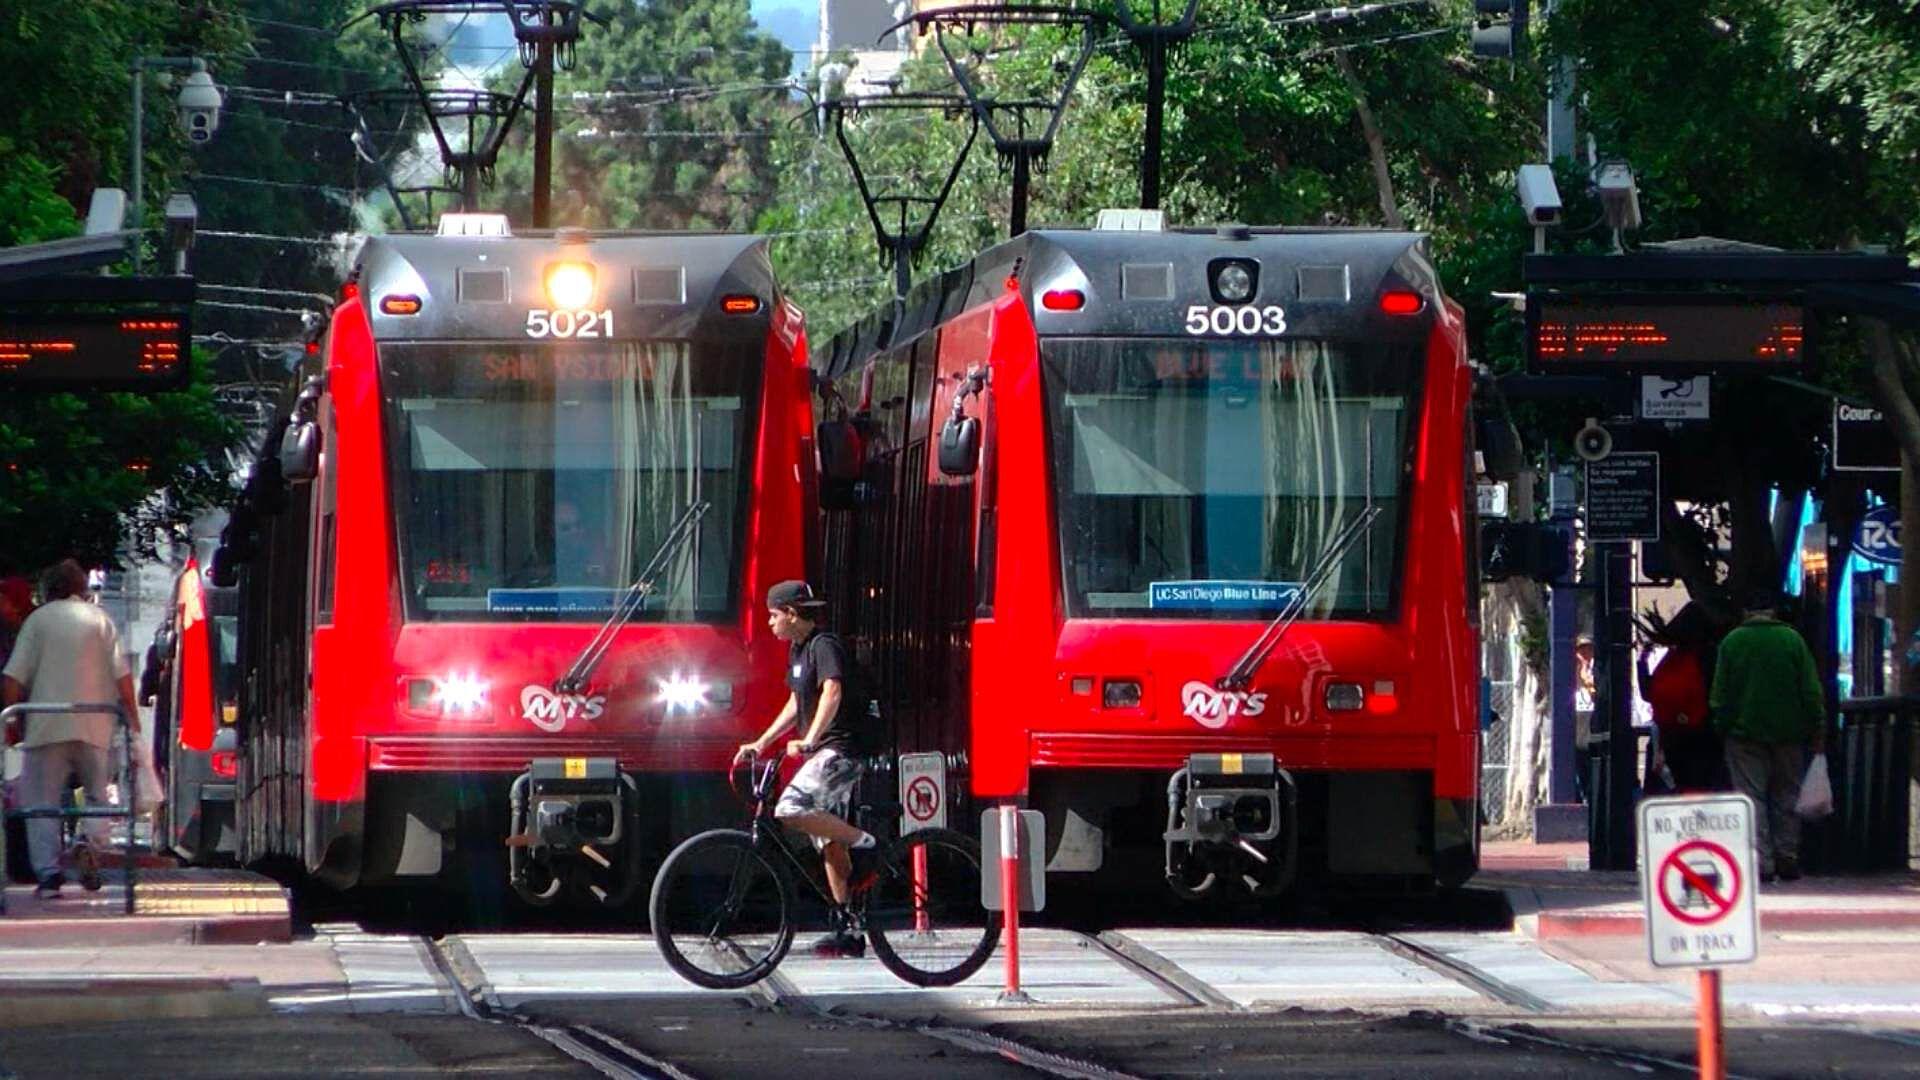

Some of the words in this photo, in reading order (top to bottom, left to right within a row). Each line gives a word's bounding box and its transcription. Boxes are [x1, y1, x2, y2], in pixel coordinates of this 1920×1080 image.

[525, 308, 614, 338] 5021
[1185, 305, 1287, 335] 5003
[1155, 588, 1172, 601] UC
[1173, 588, 1192, 601] San
[1193, 588, 1223, 603] Diego
[1224, 588, 1250, 601] Blue
[1251, 588, 1277, 601] Line
[522, 694, 607, 720] MTS
[1183, 690, 1268, 717] MTS
[1654, 816, 1672, 833] NO
[1680, 813, 1741, 833] VEHICLES
[1670, 935, 1688, 951] ON
[1695, 933, 1736, 951] TRACK
